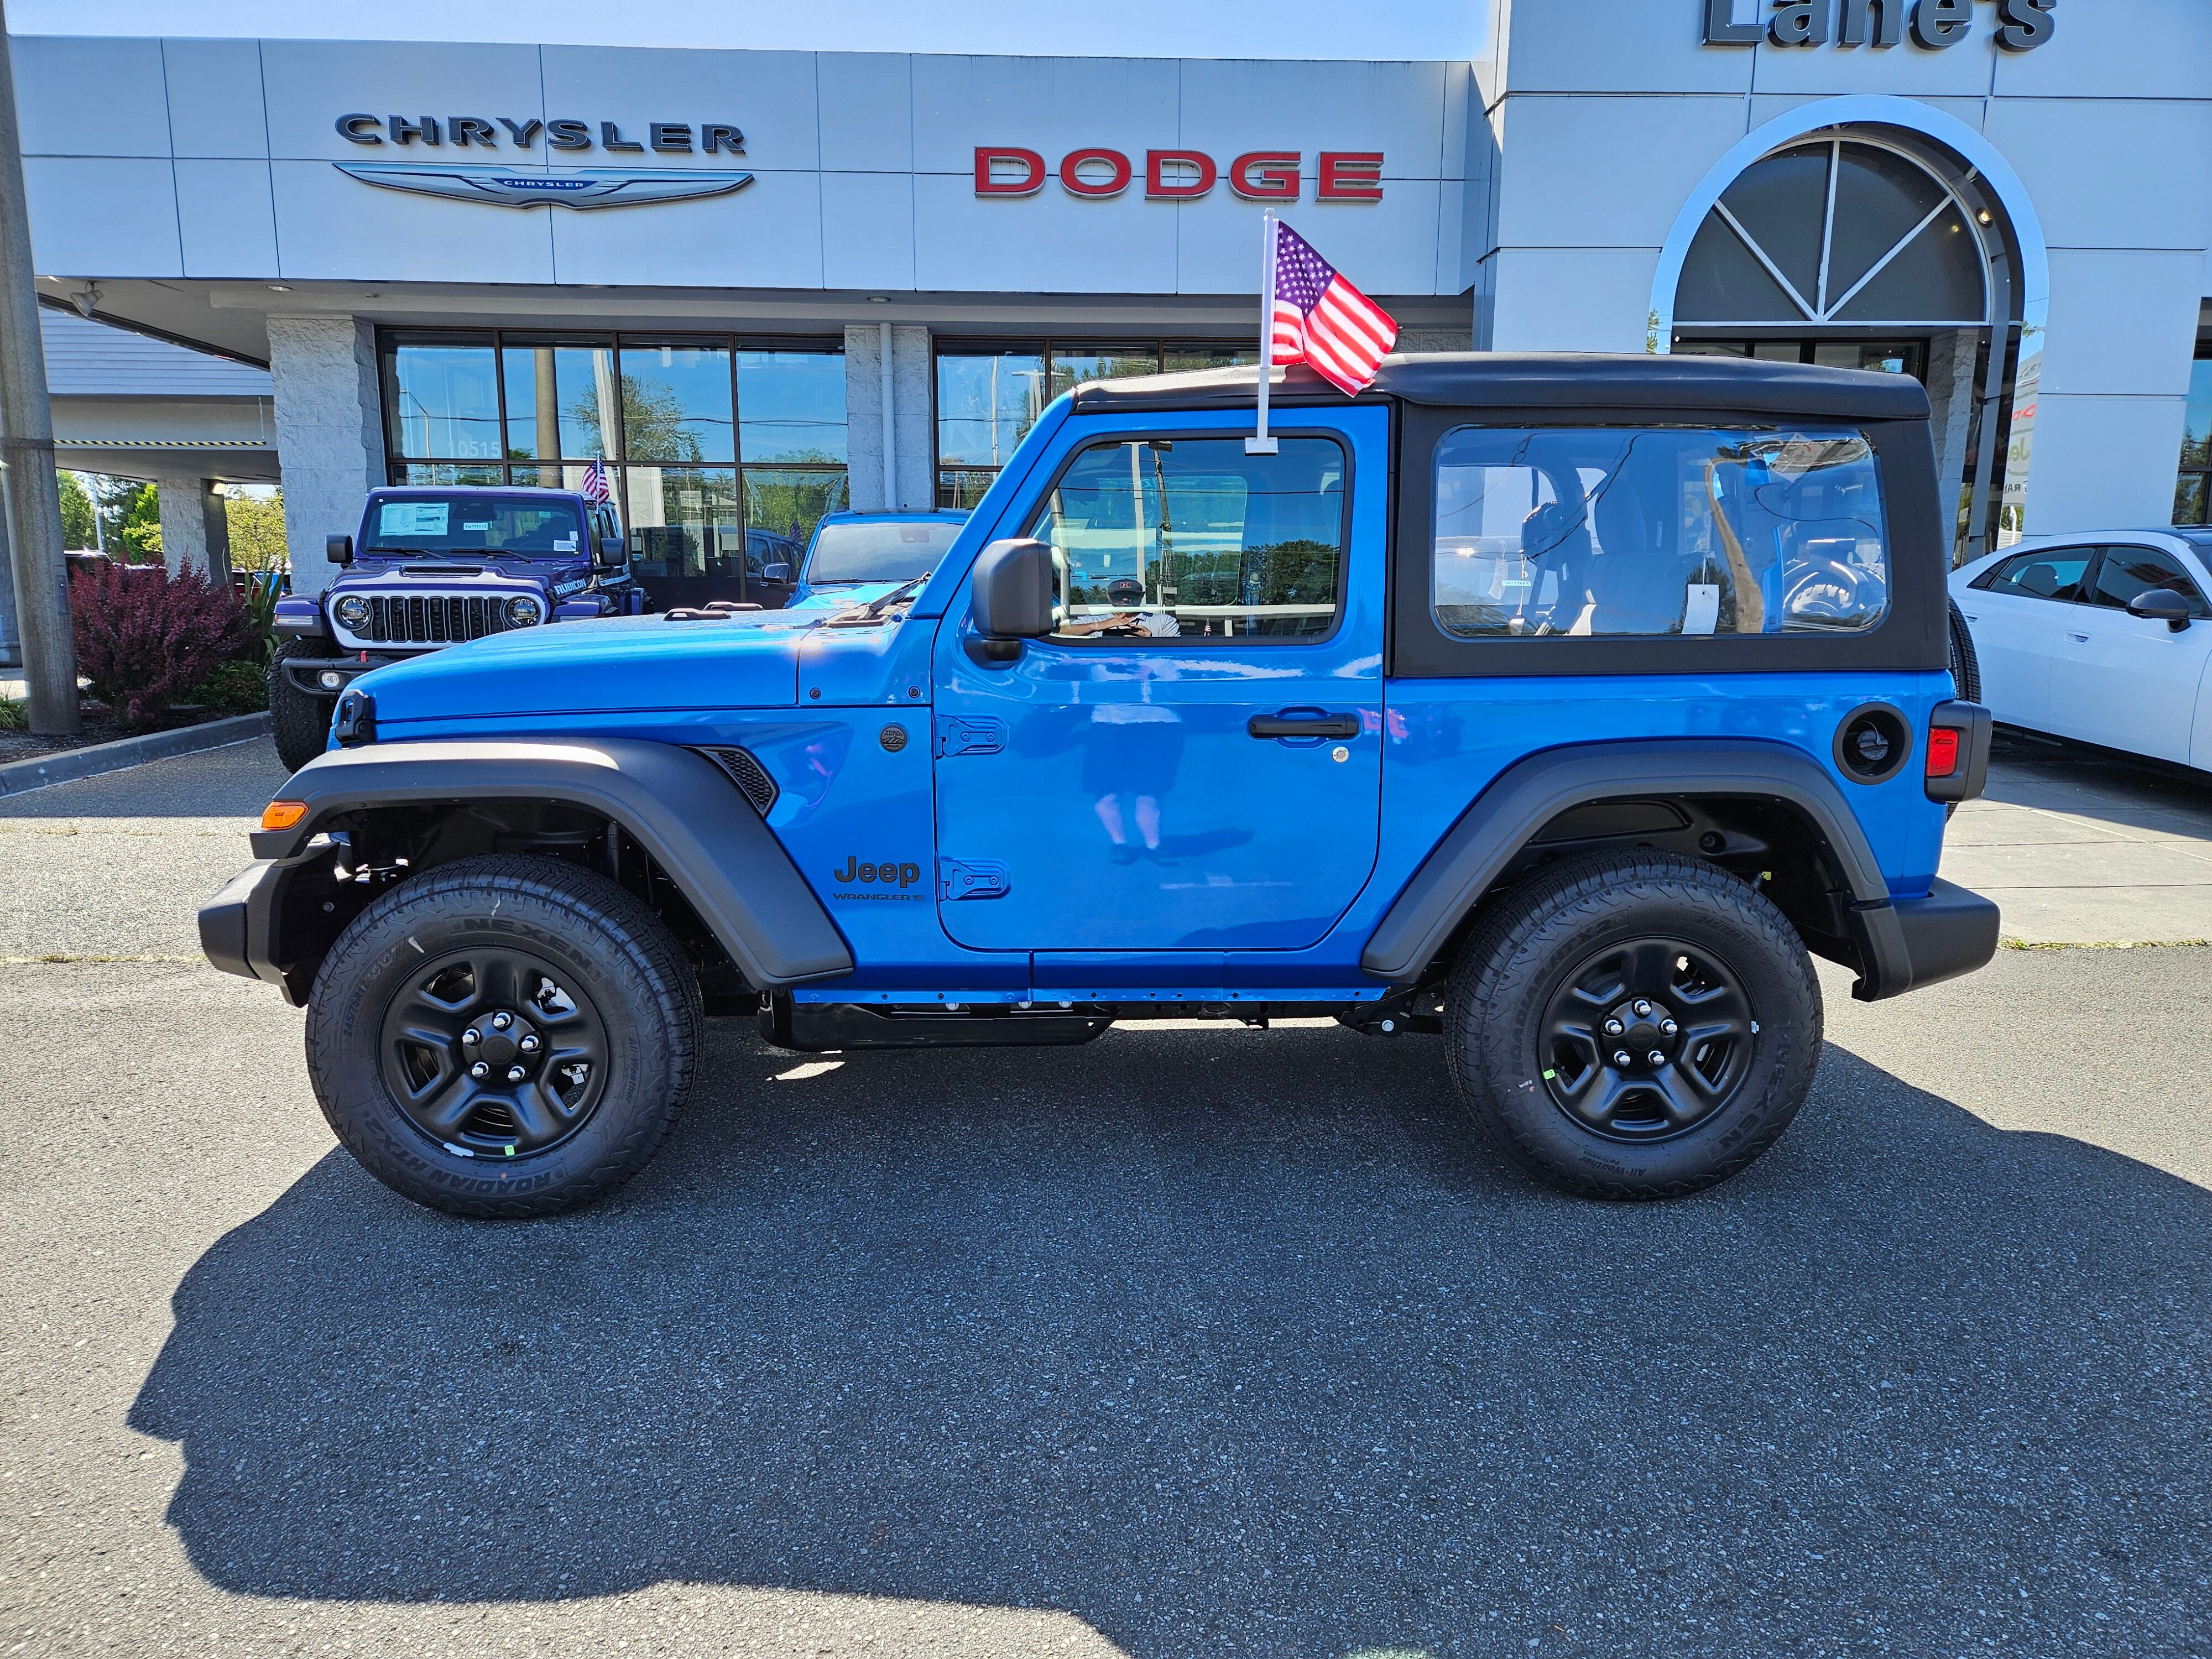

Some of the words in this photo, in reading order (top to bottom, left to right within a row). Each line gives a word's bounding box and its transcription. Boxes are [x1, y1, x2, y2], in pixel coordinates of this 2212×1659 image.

[1703, 0, 2057, 52] Lanes
[335, 113, 746, 155] CHRYSLER
[974, 147, 1384, 202] DODGE
[448, 441, 500, 457] 10515
[554, 578, 587, 595] RUBICON
[834, 855, 920, 889] Jeep
[832, 893, 911, 901] WRANGLER
[463, 918, 593, 968] NEXEN
[625, 1037, 639, 1104] All-Weather
[365, 1118, 430, 1172] HTX2
[1583, 1150, 1620, 1165] Performance
[428, 1169, 551, 1194] ROADIAN
[1578, 1156, 1647, 1177] All-Weather
